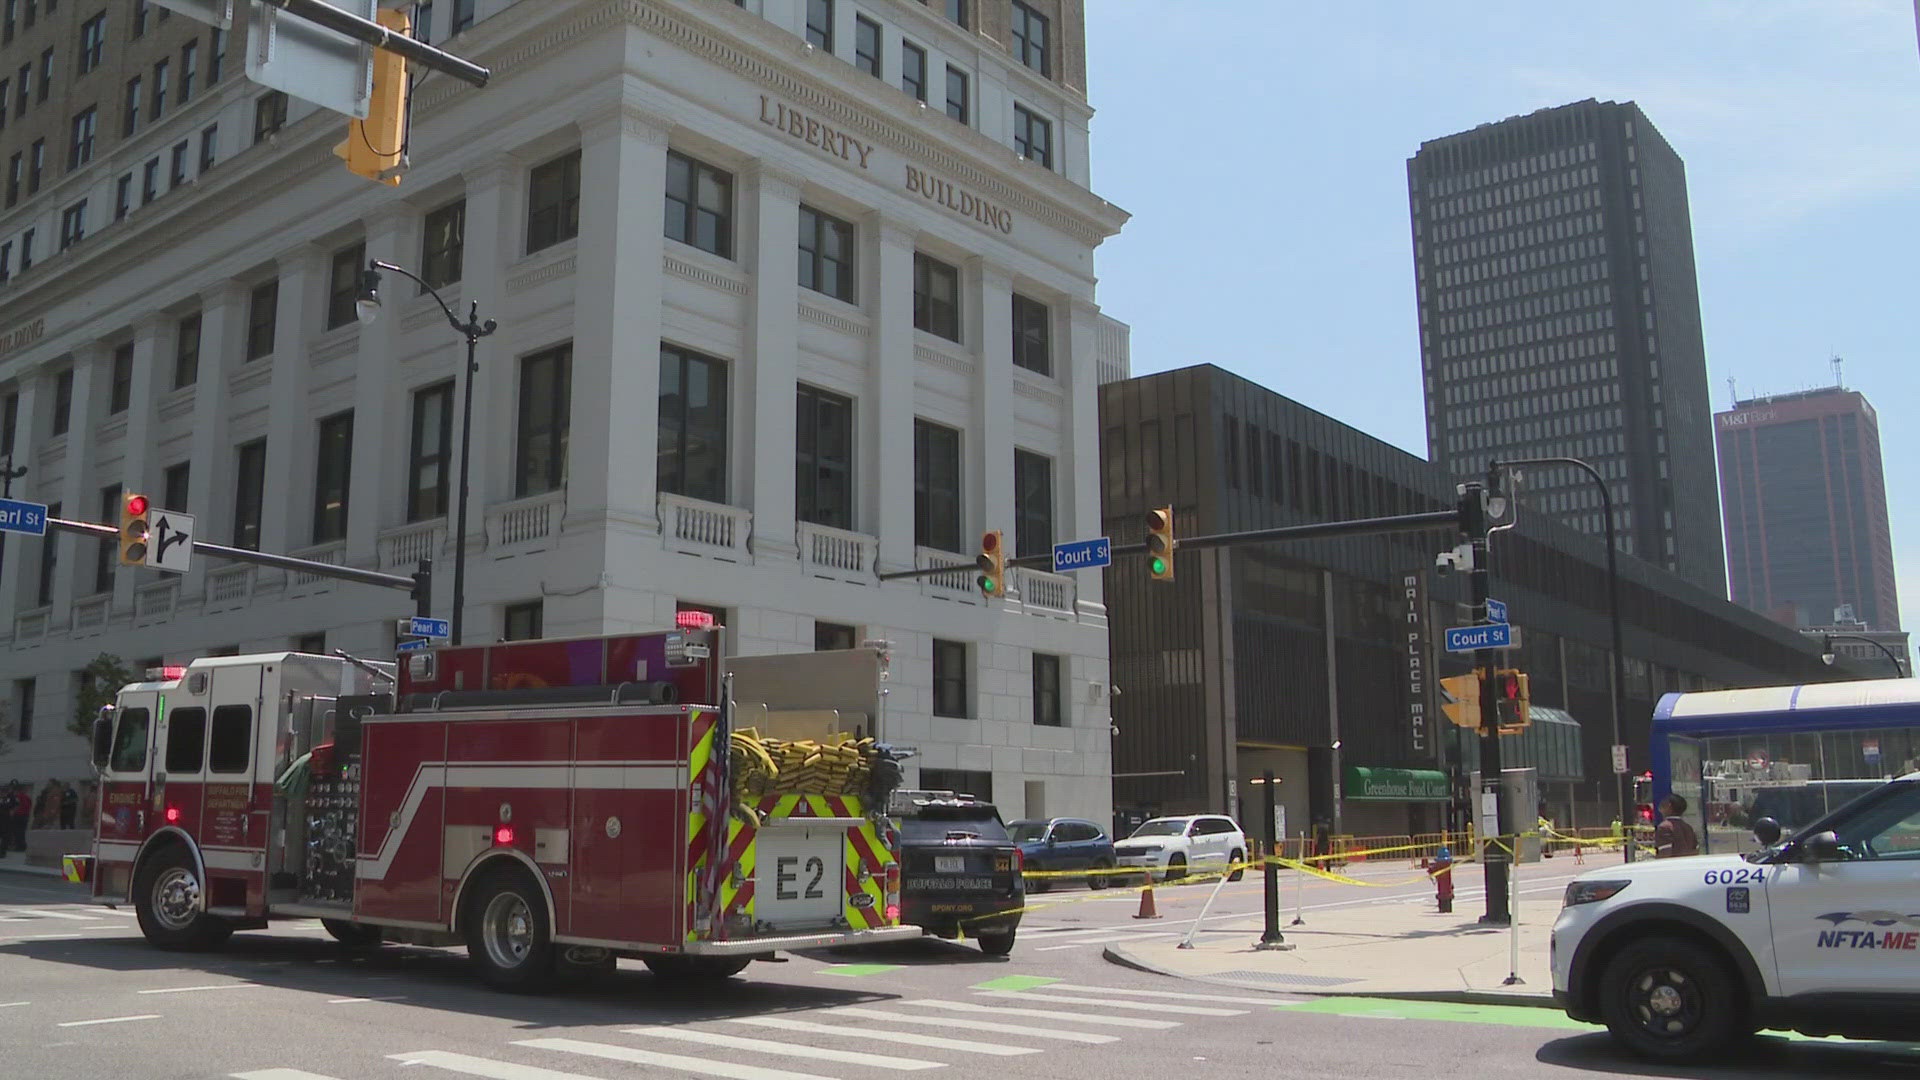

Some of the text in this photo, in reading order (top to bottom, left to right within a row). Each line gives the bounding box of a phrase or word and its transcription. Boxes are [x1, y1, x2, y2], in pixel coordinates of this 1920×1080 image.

[759, 95, 1012, 235] LIBERTY BUILDING
[1721, 409, 1777, 427] M&T Bank
[25, 512, 39, 526] St
[1056, 546, 1108, 566] Court St
[412, 621, 447, 635] Pearl St
[1452, 630, 1504, 646] Court St
[1404, 576, 1424, 750] MAIN PLACE MALL
[1364, 779, 1407, 796] Greenhouse
[1408, 780, 1426, 796] Food
[1427, 781, 1446, 796] Court
[776, 855, 824, 900] E2
[906, 878, 993, 890] BUFFALO POLICE
[1703, 867, 1766, 886] 6024
